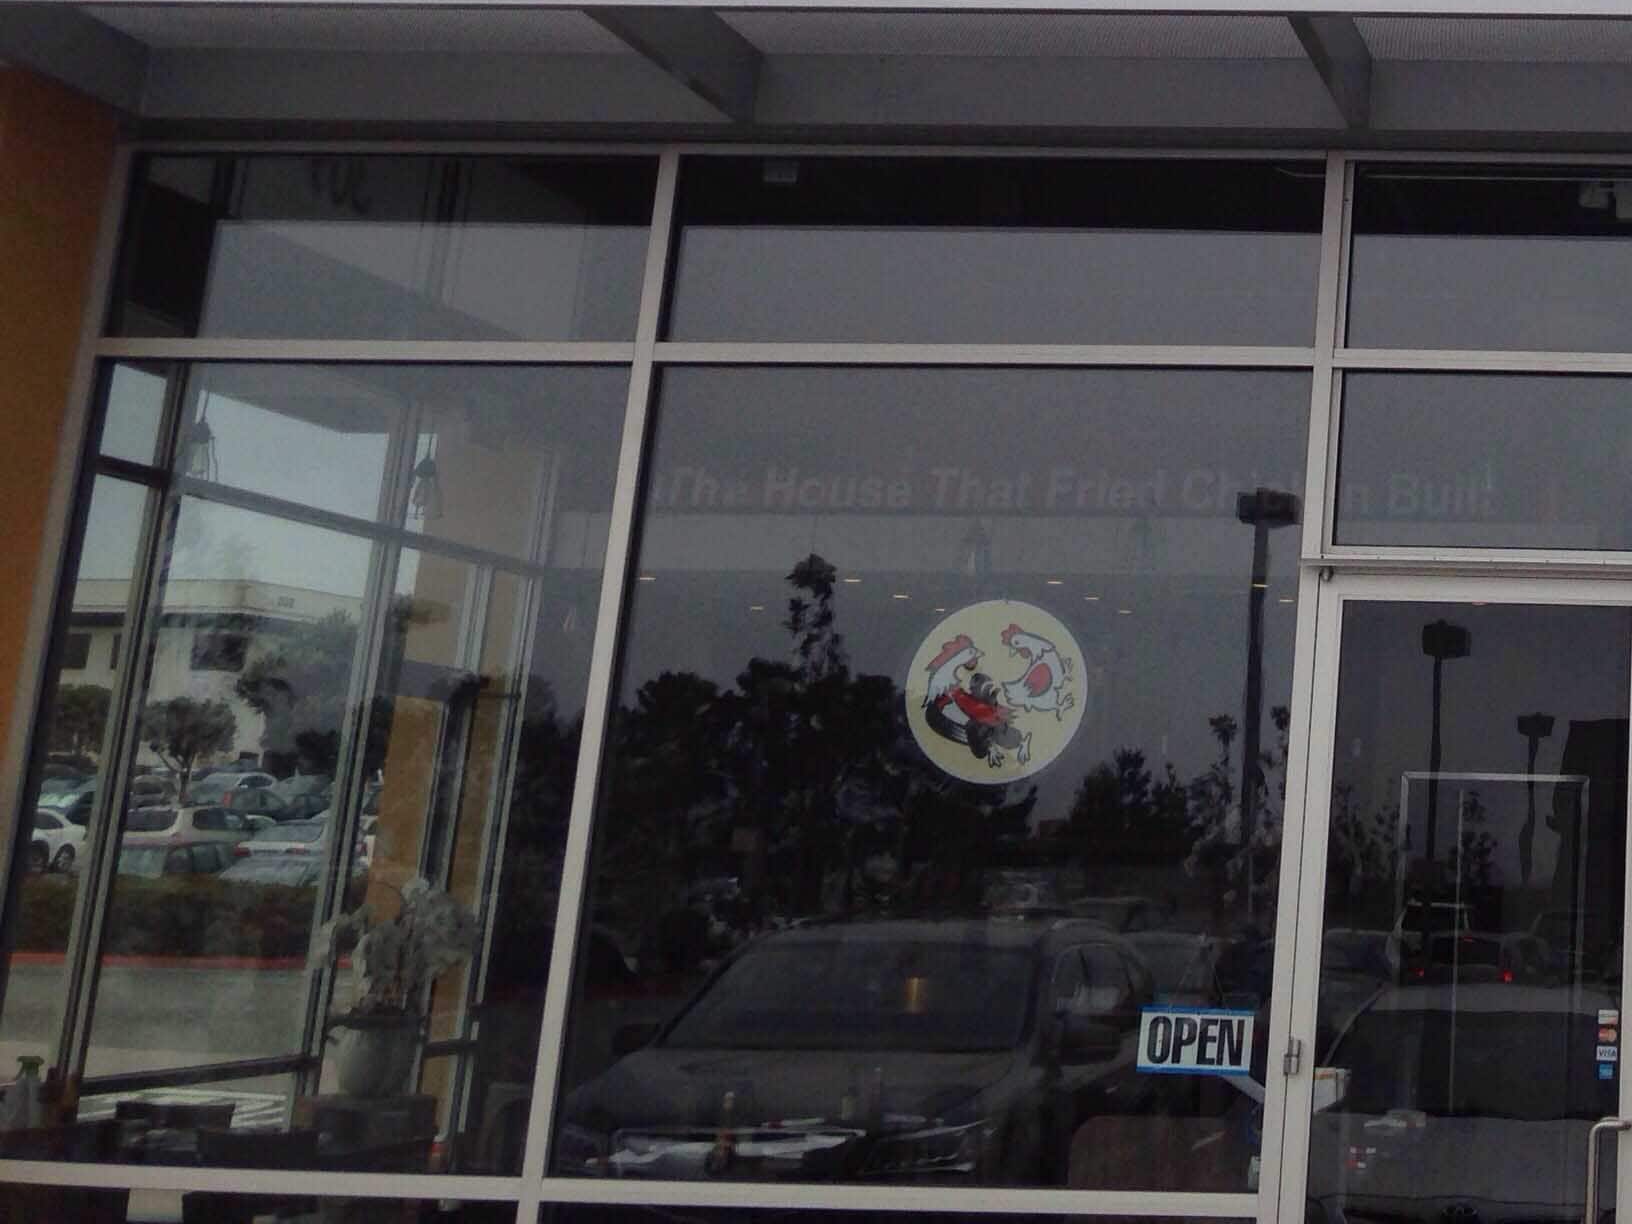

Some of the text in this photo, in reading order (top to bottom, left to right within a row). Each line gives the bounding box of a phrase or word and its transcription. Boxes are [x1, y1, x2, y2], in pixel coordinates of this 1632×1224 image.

[762, 464, 914, 510] House
[929, 465, 1032, 510] That
[1147, 1015, 1245, 1066] OPEN
